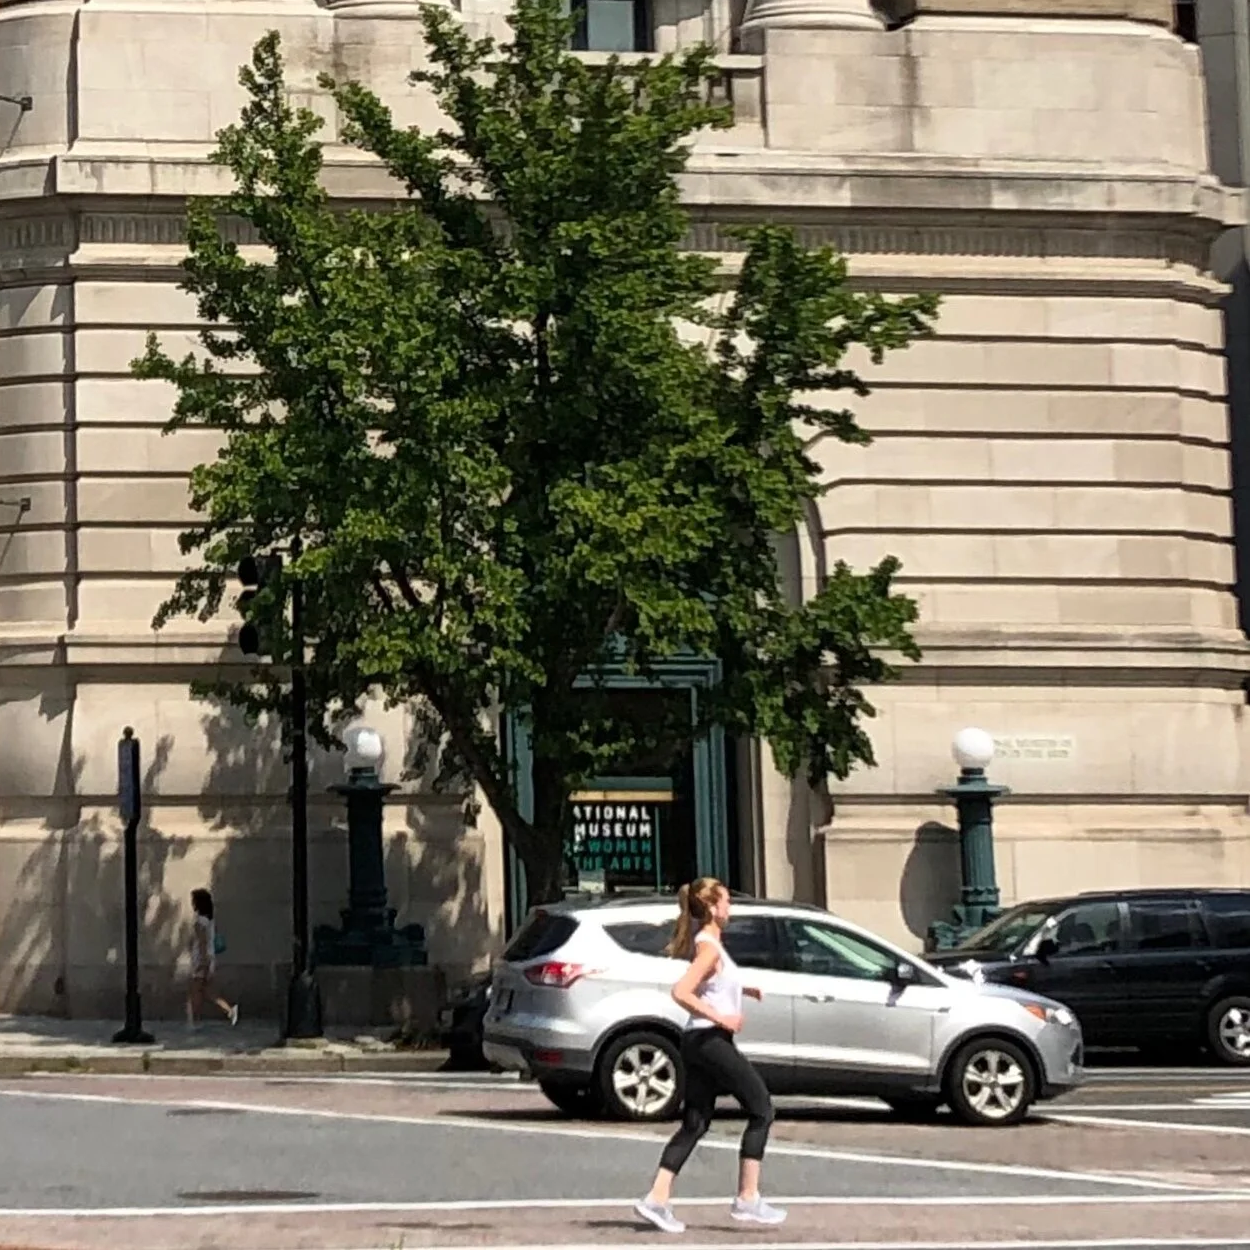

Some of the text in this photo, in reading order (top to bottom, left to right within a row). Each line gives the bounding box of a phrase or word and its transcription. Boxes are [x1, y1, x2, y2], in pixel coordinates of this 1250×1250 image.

[574, 822, 651, 838] MUSEUM
[589, 839, 651, 854] WOMEN
[610, 856, 652, 870] ARTS
